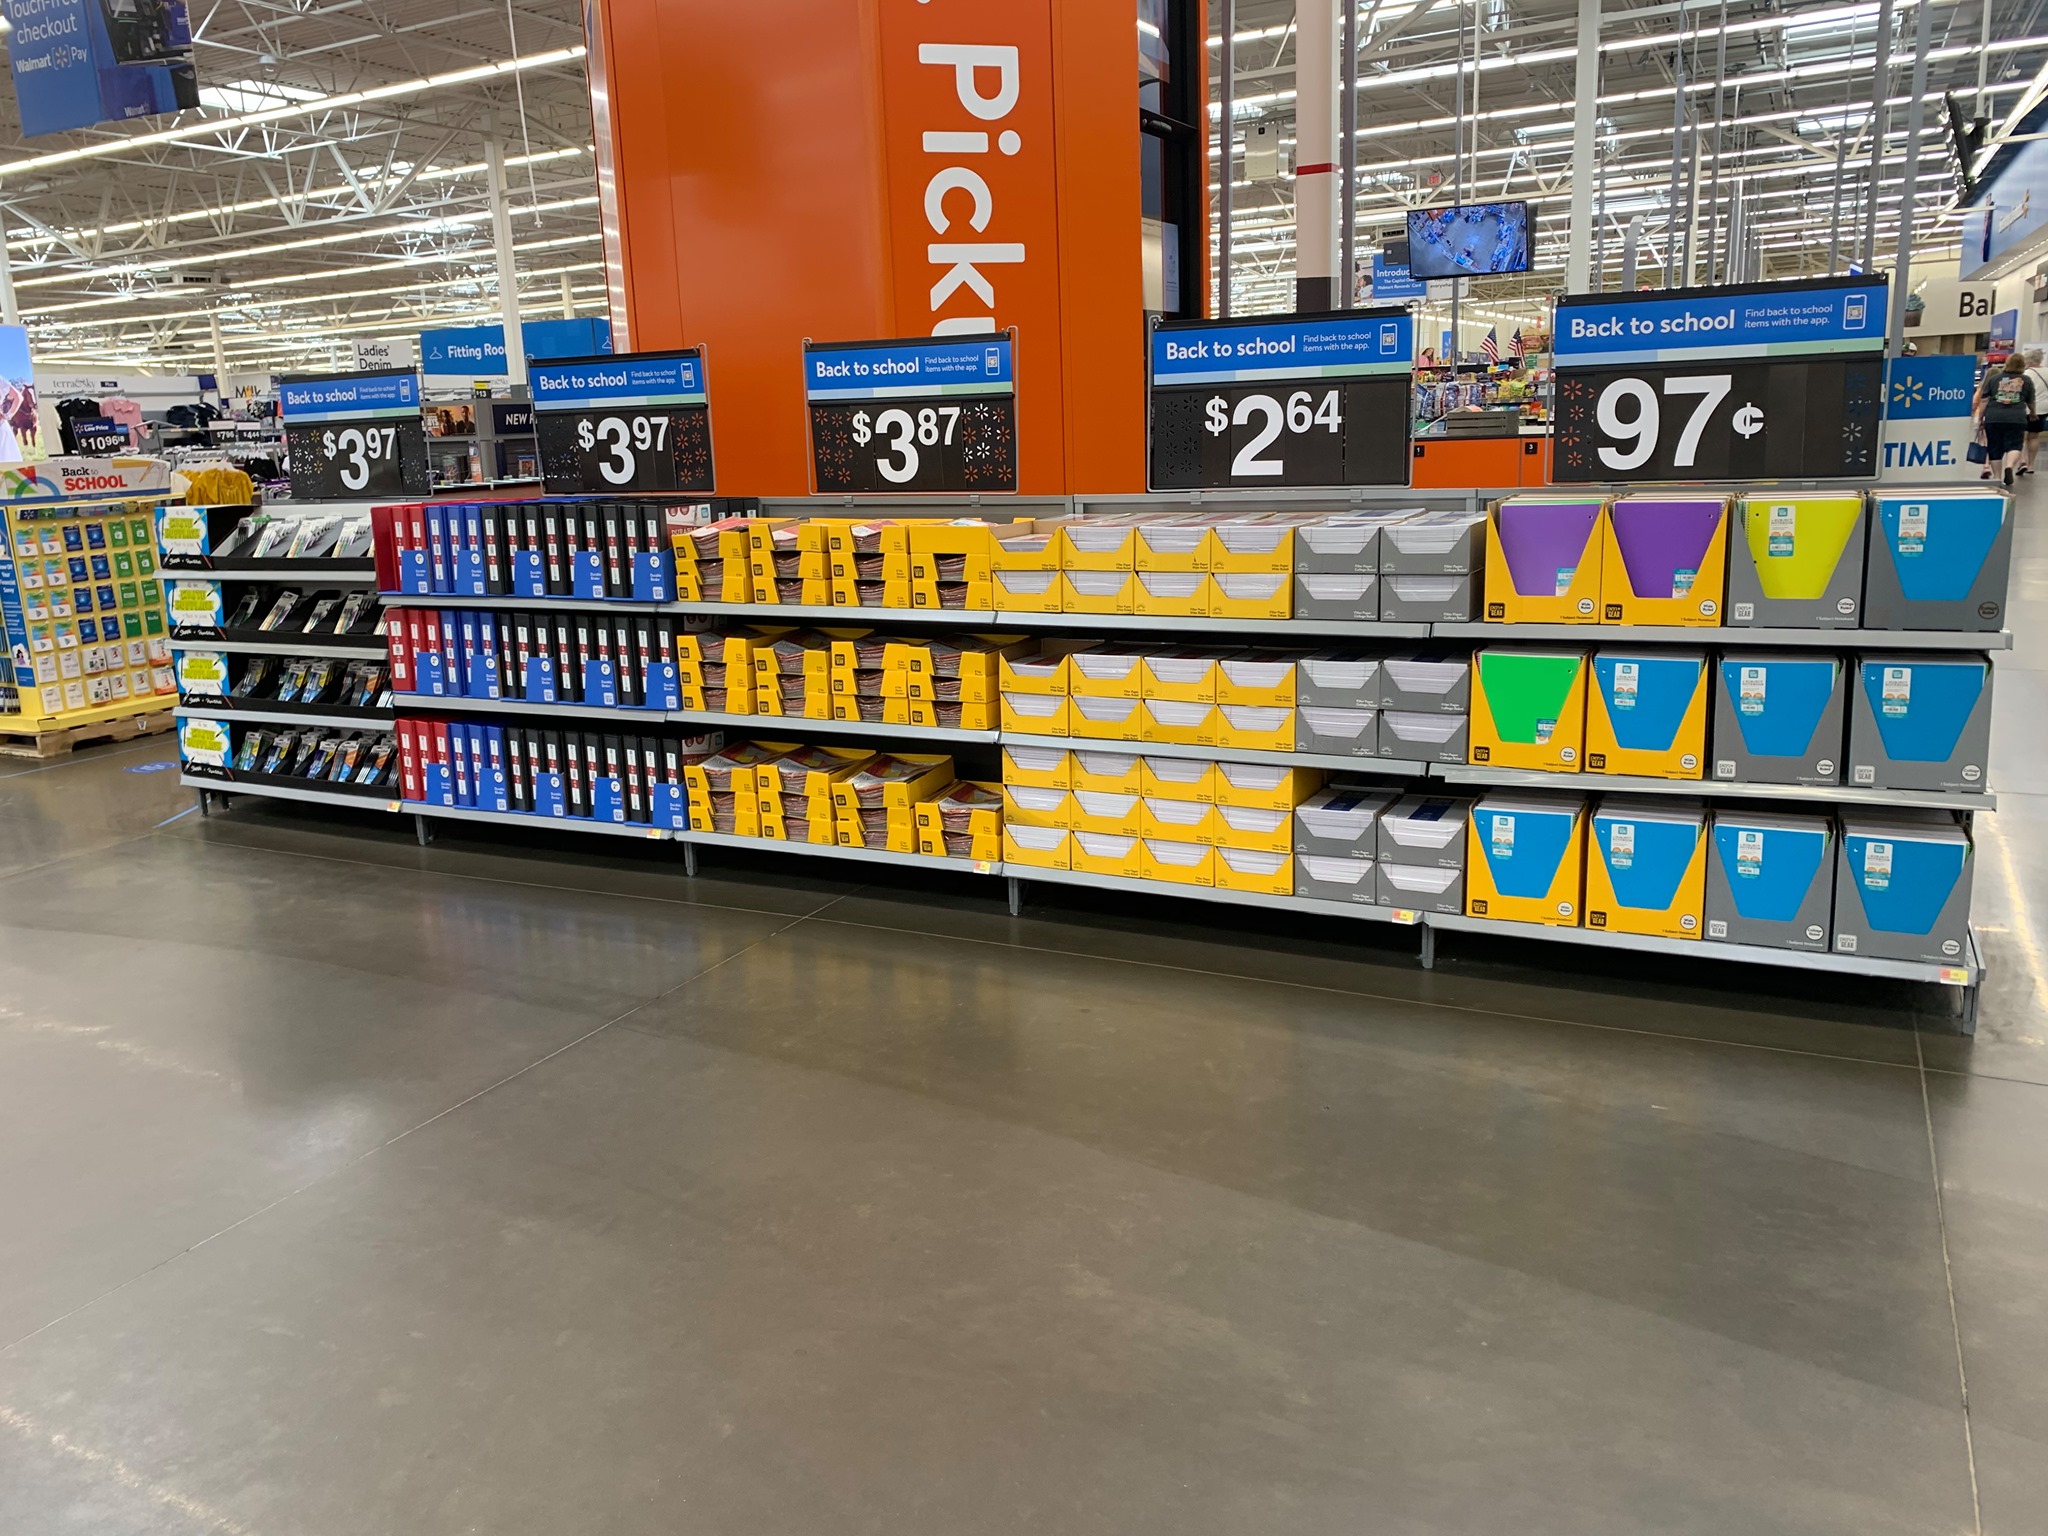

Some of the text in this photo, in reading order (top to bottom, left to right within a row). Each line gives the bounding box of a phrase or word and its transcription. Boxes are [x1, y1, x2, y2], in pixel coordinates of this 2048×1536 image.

[17, 14, 78, 44] checkout
[16, 46, 88, 73] Walmart Pay
[1376, 268, 1410, 277] Introduc
[1745, 303, 1832, 317] Find back to school
[1571, 308, 1735, 338] Back to school
[1744, 316, 1829, 328] items with the app.
[1303, 334, 1318, 342] Find
[1319, 333, 1336, 341] back
[1347, 331, 1371, 340] school
[358, 344, 390, 357] Ladies'
[447, 344, 506, 361] Fitting Roo
[1166, 334, 1295, 360] Back to school
[1323, 342, 1339, 350] with
[1354, 342, 1369, 351] app.
[359, 357, 392, 369] Denim
[924, 356, 937, 364] Find
[959, 354, 978, 362] school
[815, 356, 919, 377] Back to school
[965, 364, 977, 372] app.
[539, 370, 627, 390] Back to school
[287, 387, 357, 404] Back to school
[1928, 387, 1966, 401] Photo
[505, 413, 528, 426] NEW
[1884, 440, 1957, 468] TIME.
[61, 467, 89, 477] Back
[65, 475, 128, 491] SCHOOL
